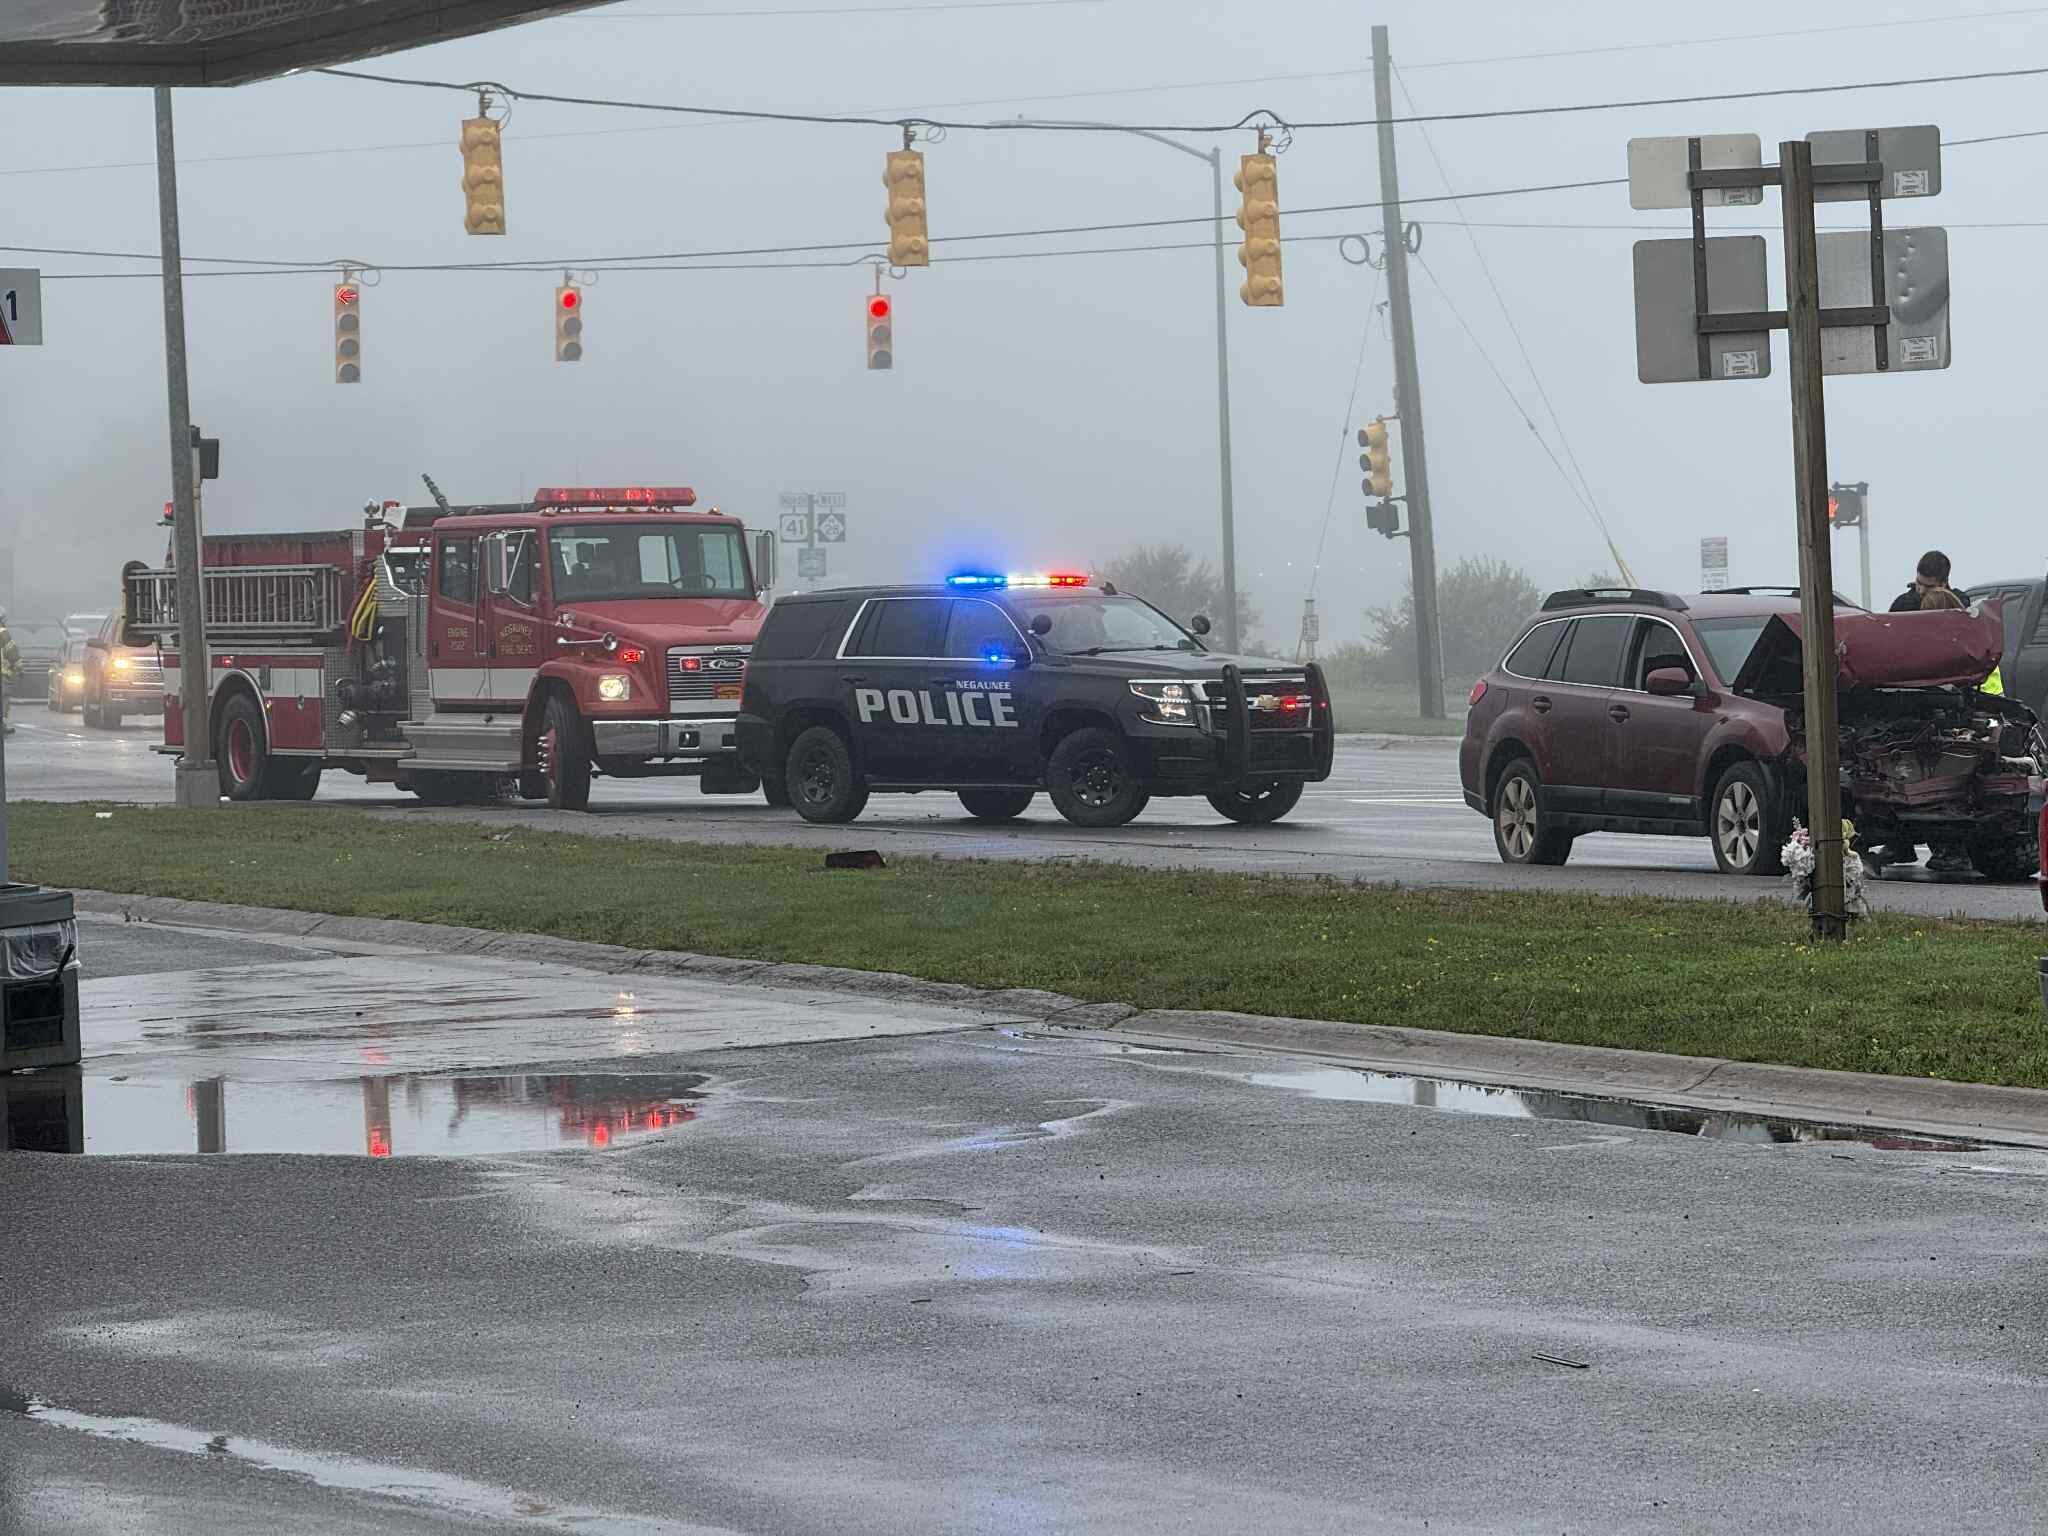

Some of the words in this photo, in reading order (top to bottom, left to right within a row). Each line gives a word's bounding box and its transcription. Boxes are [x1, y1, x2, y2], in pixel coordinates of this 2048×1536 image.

[6, 290, 17, 321] 1
[785, 519, 804, 536] 41
[956, 680, 1011, 690] NEGAUNEE
[855, 688, 1018, 728] POLICE
